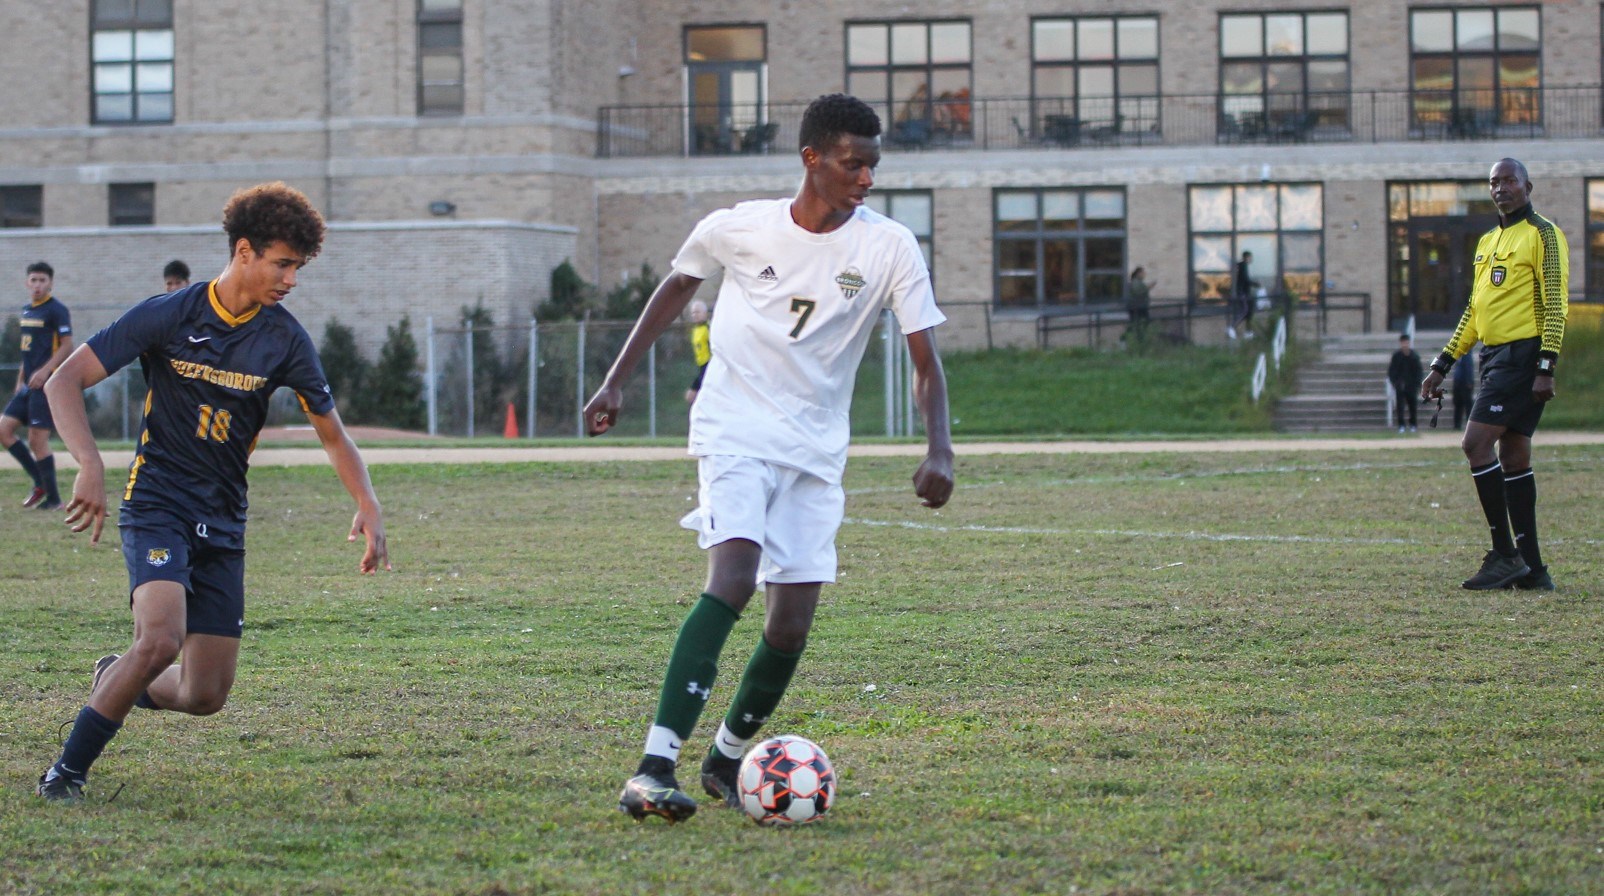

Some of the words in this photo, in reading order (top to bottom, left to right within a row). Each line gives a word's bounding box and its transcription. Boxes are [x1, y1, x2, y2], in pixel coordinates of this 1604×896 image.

[789, 298, 816, 339] 7
[195, 404, 232, 443] 18
[196, 522, 209, 538] Q
